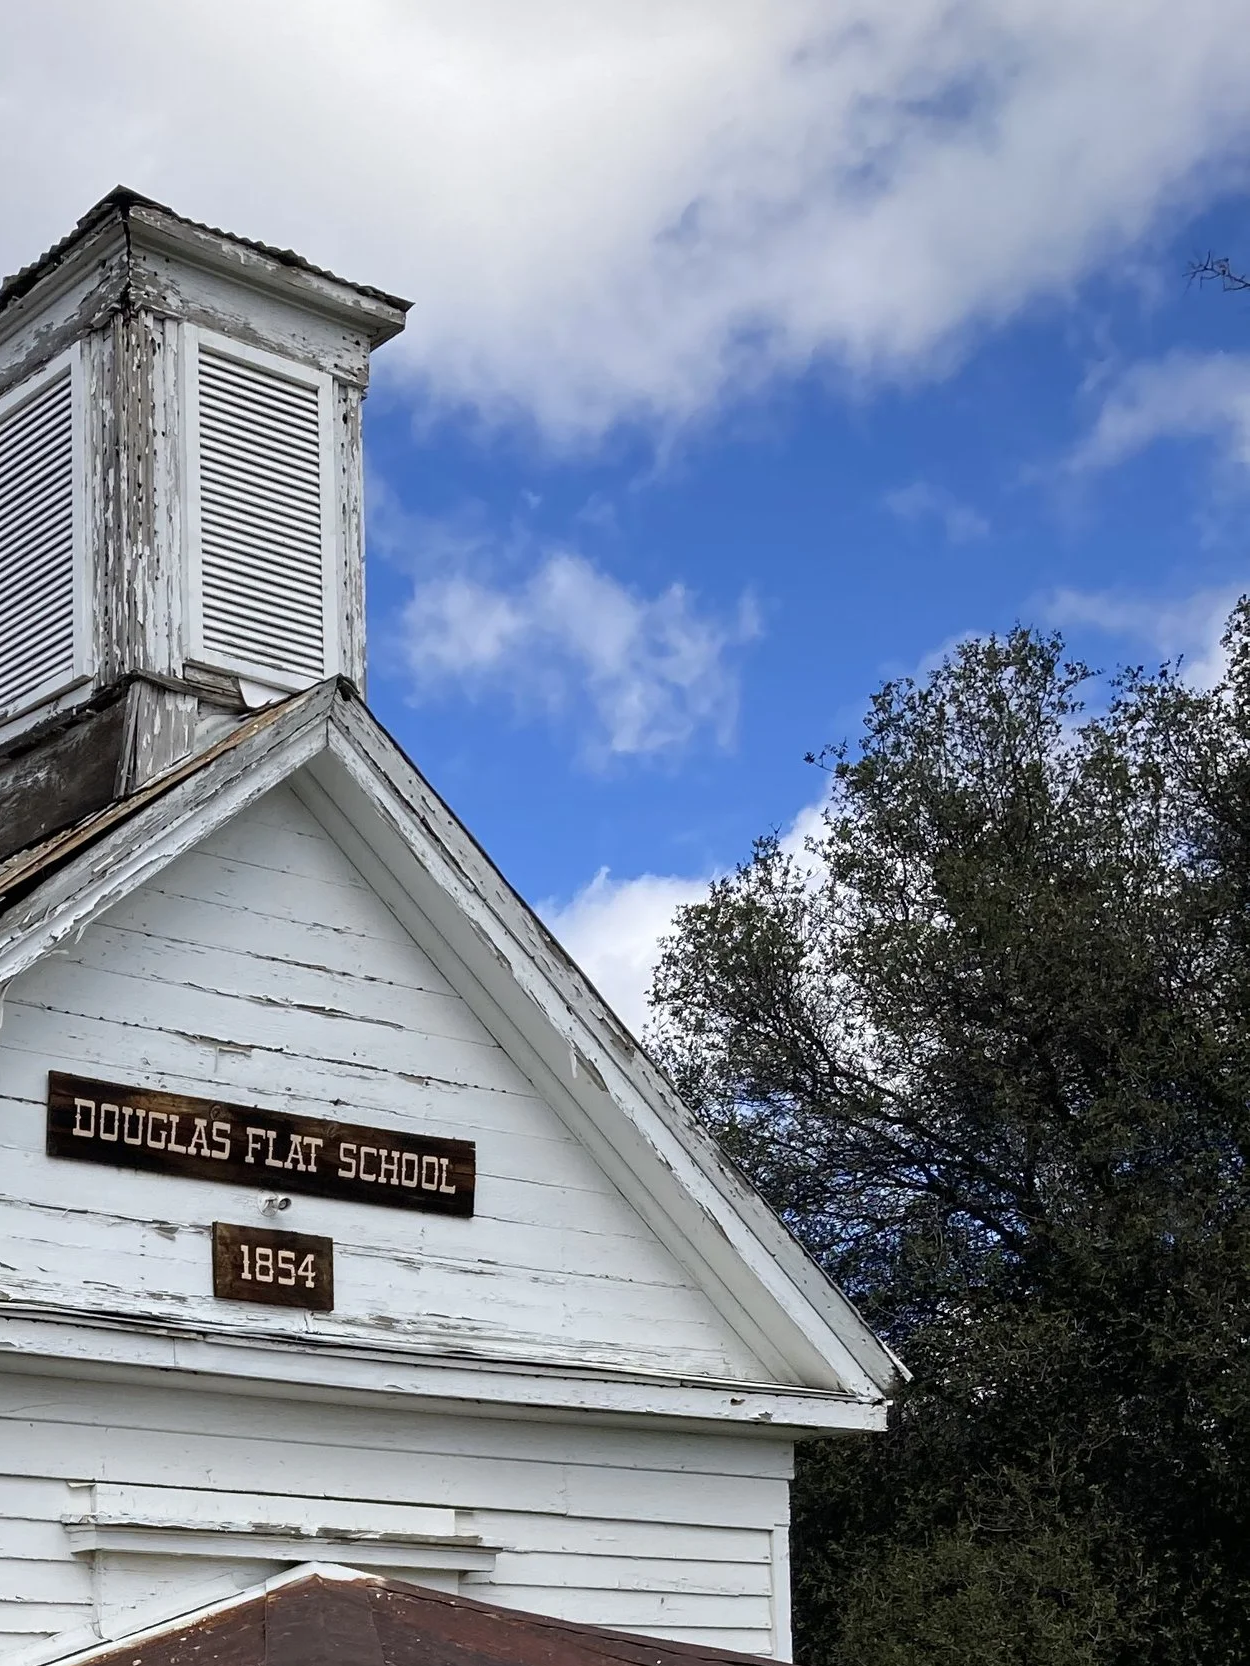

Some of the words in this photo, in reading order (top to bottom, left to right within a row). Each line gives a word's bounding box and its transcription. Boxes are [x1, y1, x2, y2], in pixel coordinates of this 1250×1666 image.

[72, 1098, 231, 1160] DOUGLAS
[244, 1127, 323, 1173] FLAT
[338, 1142, 456, 1194] SCHOOL
[240, 1244, 316, 1288] 1854
